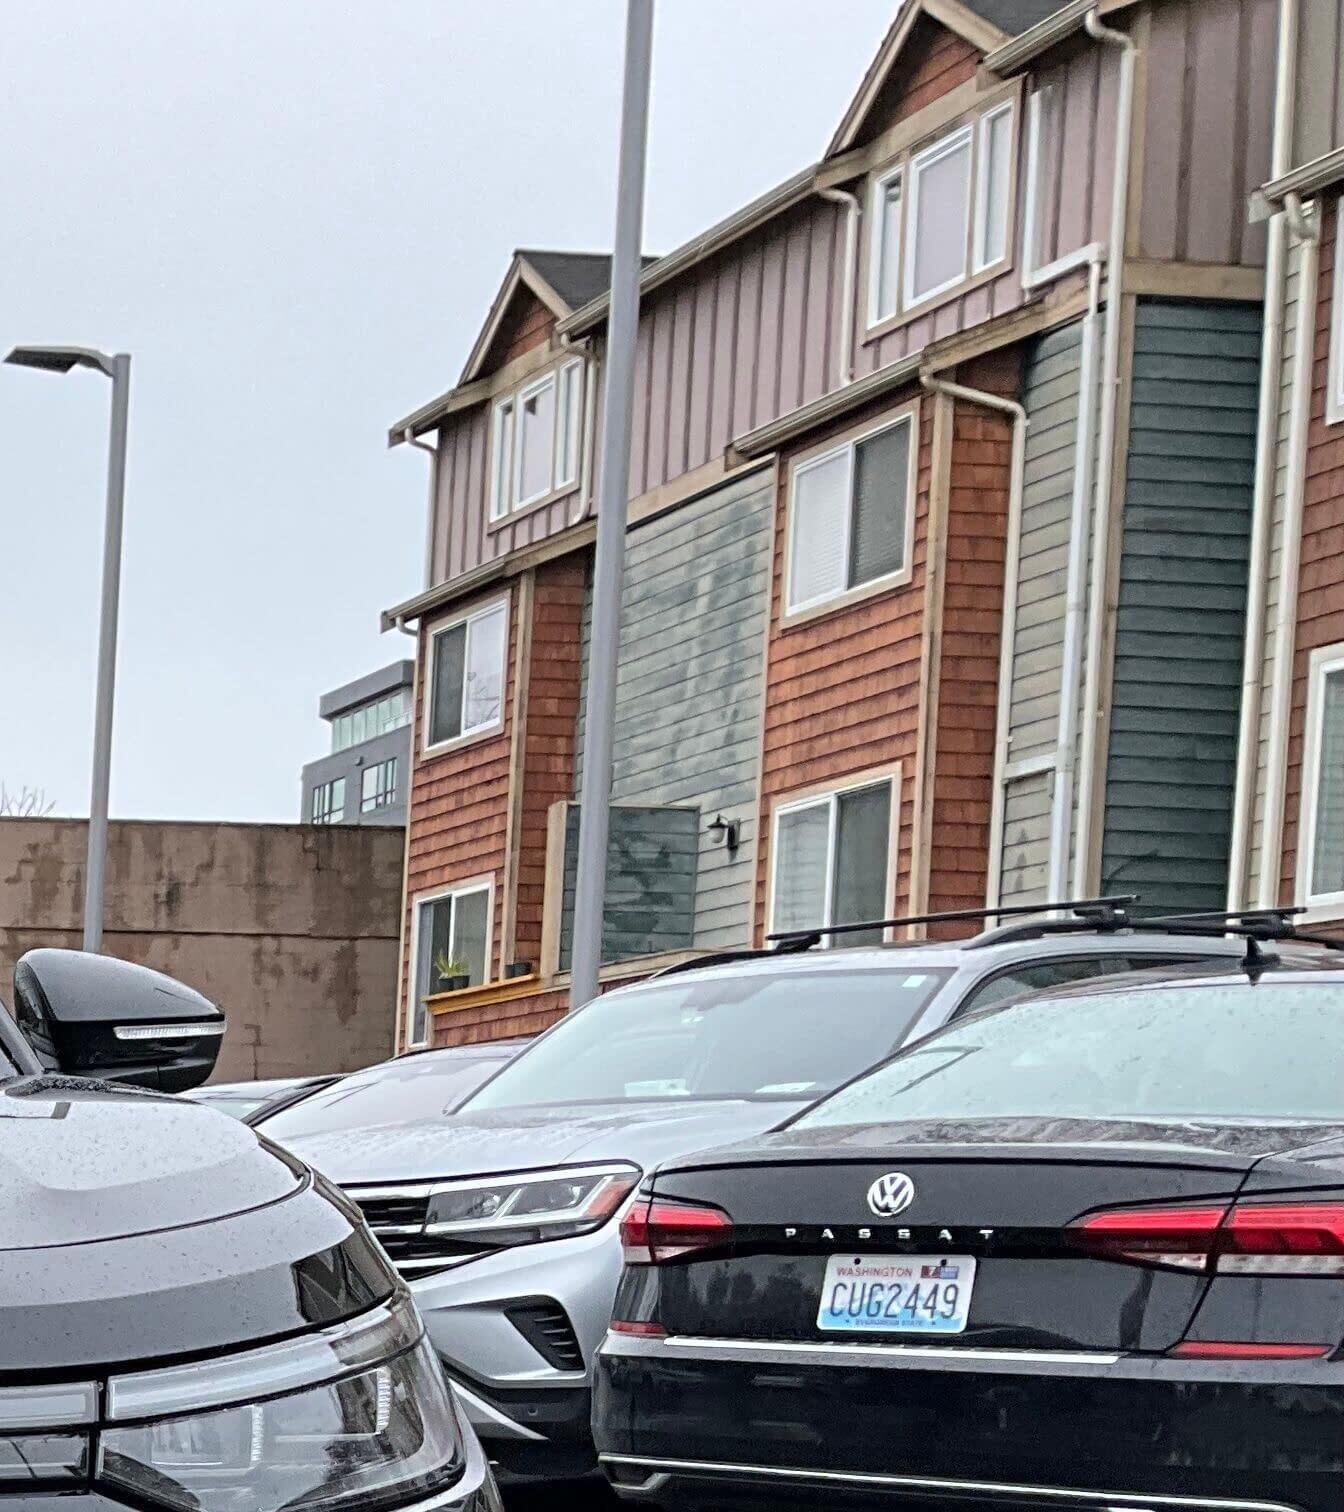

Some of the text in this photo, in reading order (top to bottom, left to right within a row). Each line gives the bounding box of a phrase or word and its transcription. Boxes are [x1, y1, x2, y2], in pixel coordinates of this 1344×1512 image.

[784, 1228, 994, 1240] PASSAT
[836, 1266, 913, 1277] WASHINGTON
[830, 1282, 959, 1319] CUG2449
